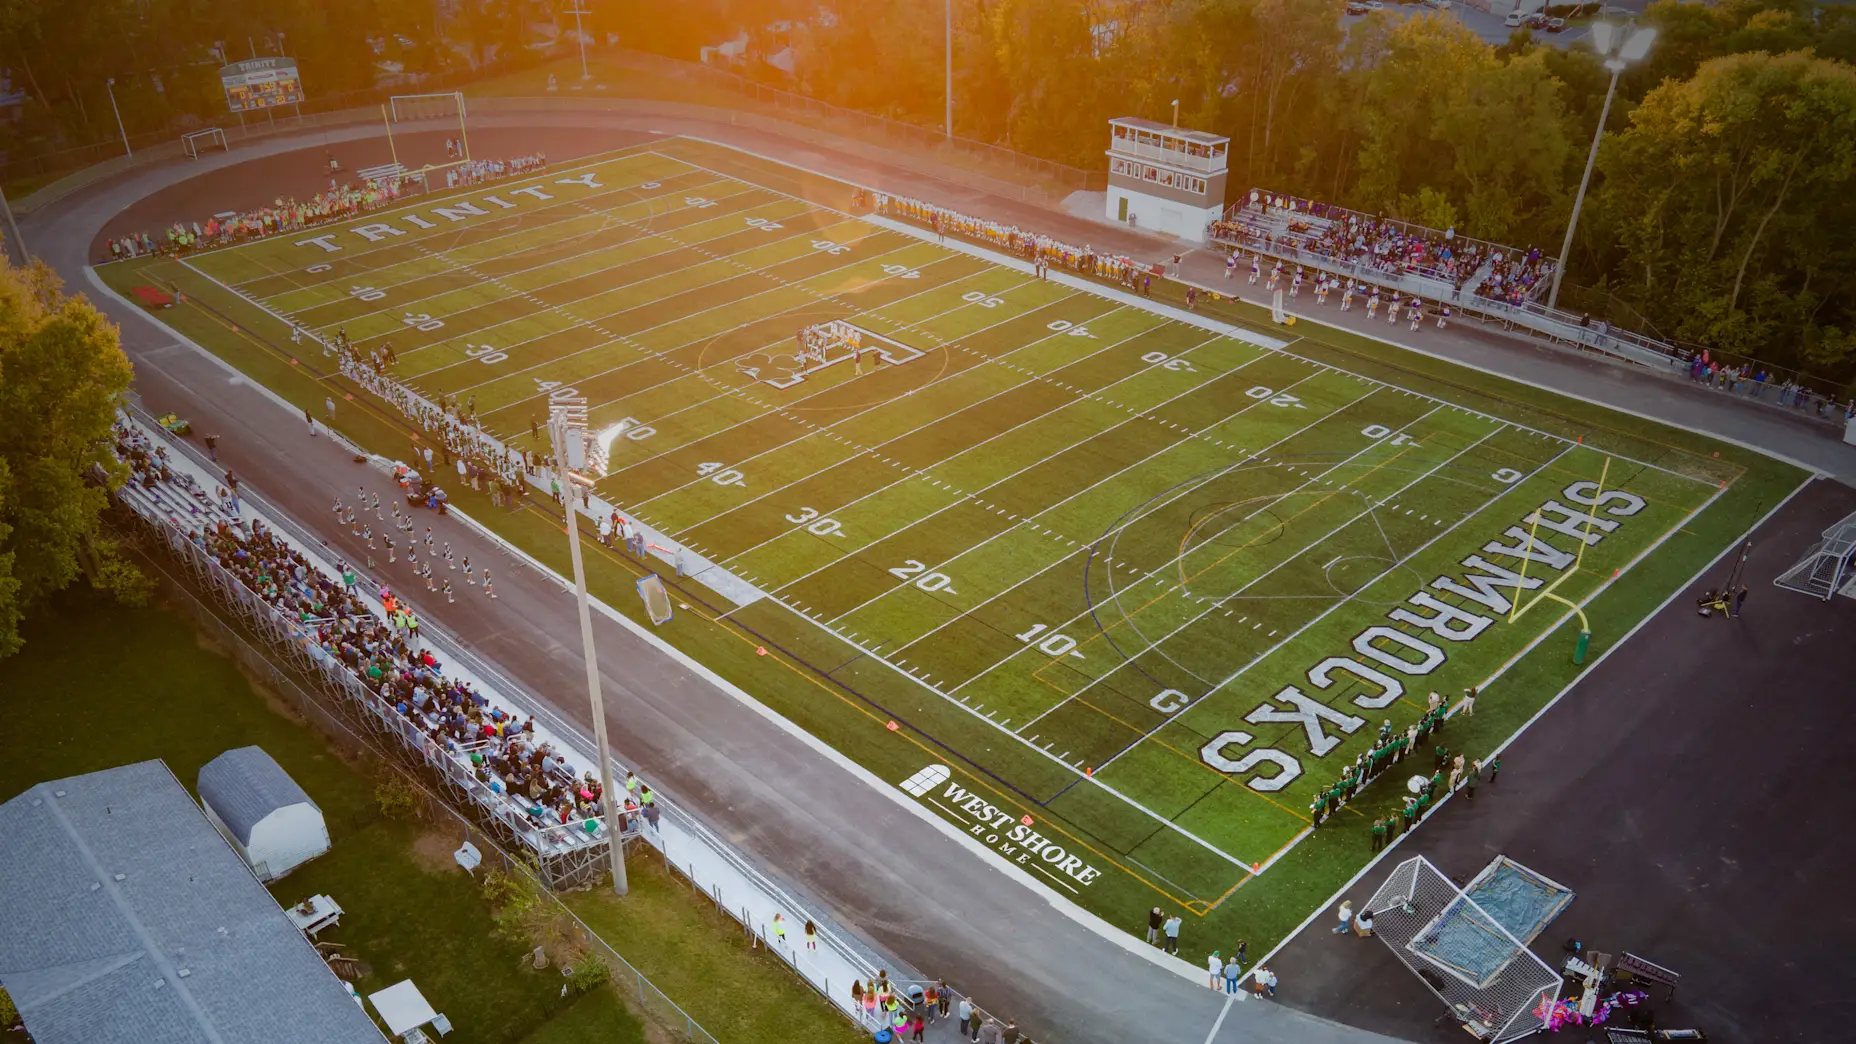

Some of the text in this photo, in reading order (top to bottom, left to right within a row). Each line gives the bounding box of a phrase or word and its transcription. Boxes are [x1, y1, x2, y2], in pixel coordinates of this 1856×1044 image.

[238, 60, 276, 72] TRINITY
[295, 172, 604, 253] TRINITY
[746, 218, 783, 231] 20
[812, 241, 851, 254] 30
[884, 265, 920, 278] 40
[962, 291, 1004, 308] 50
[403, 314, 444, 331] 20
[1046, 320, 1089, 336] 40
[465, 344, 508, 364] 30
[1141, 351, 1190, 372] 30
[536, 380, 579, 400] 40
[1245, 385, 1302, 408] 20
[1361, 424, 1416, 446] 10
[696, 461, 744, 487] 40
[1491, 468, 1523, 484] G
[785, 507, 841, 535] 30
[888, 559, 951, 593] 20
[1015, 624, 1077, 655] 10
[1197, 479, 1648, 793] SHAMROCKS
[1150, 689, 1189, 713] G
[943, 781, 1102, 886] WEST SHORE
[969, 824, 1031, 864] HOME
